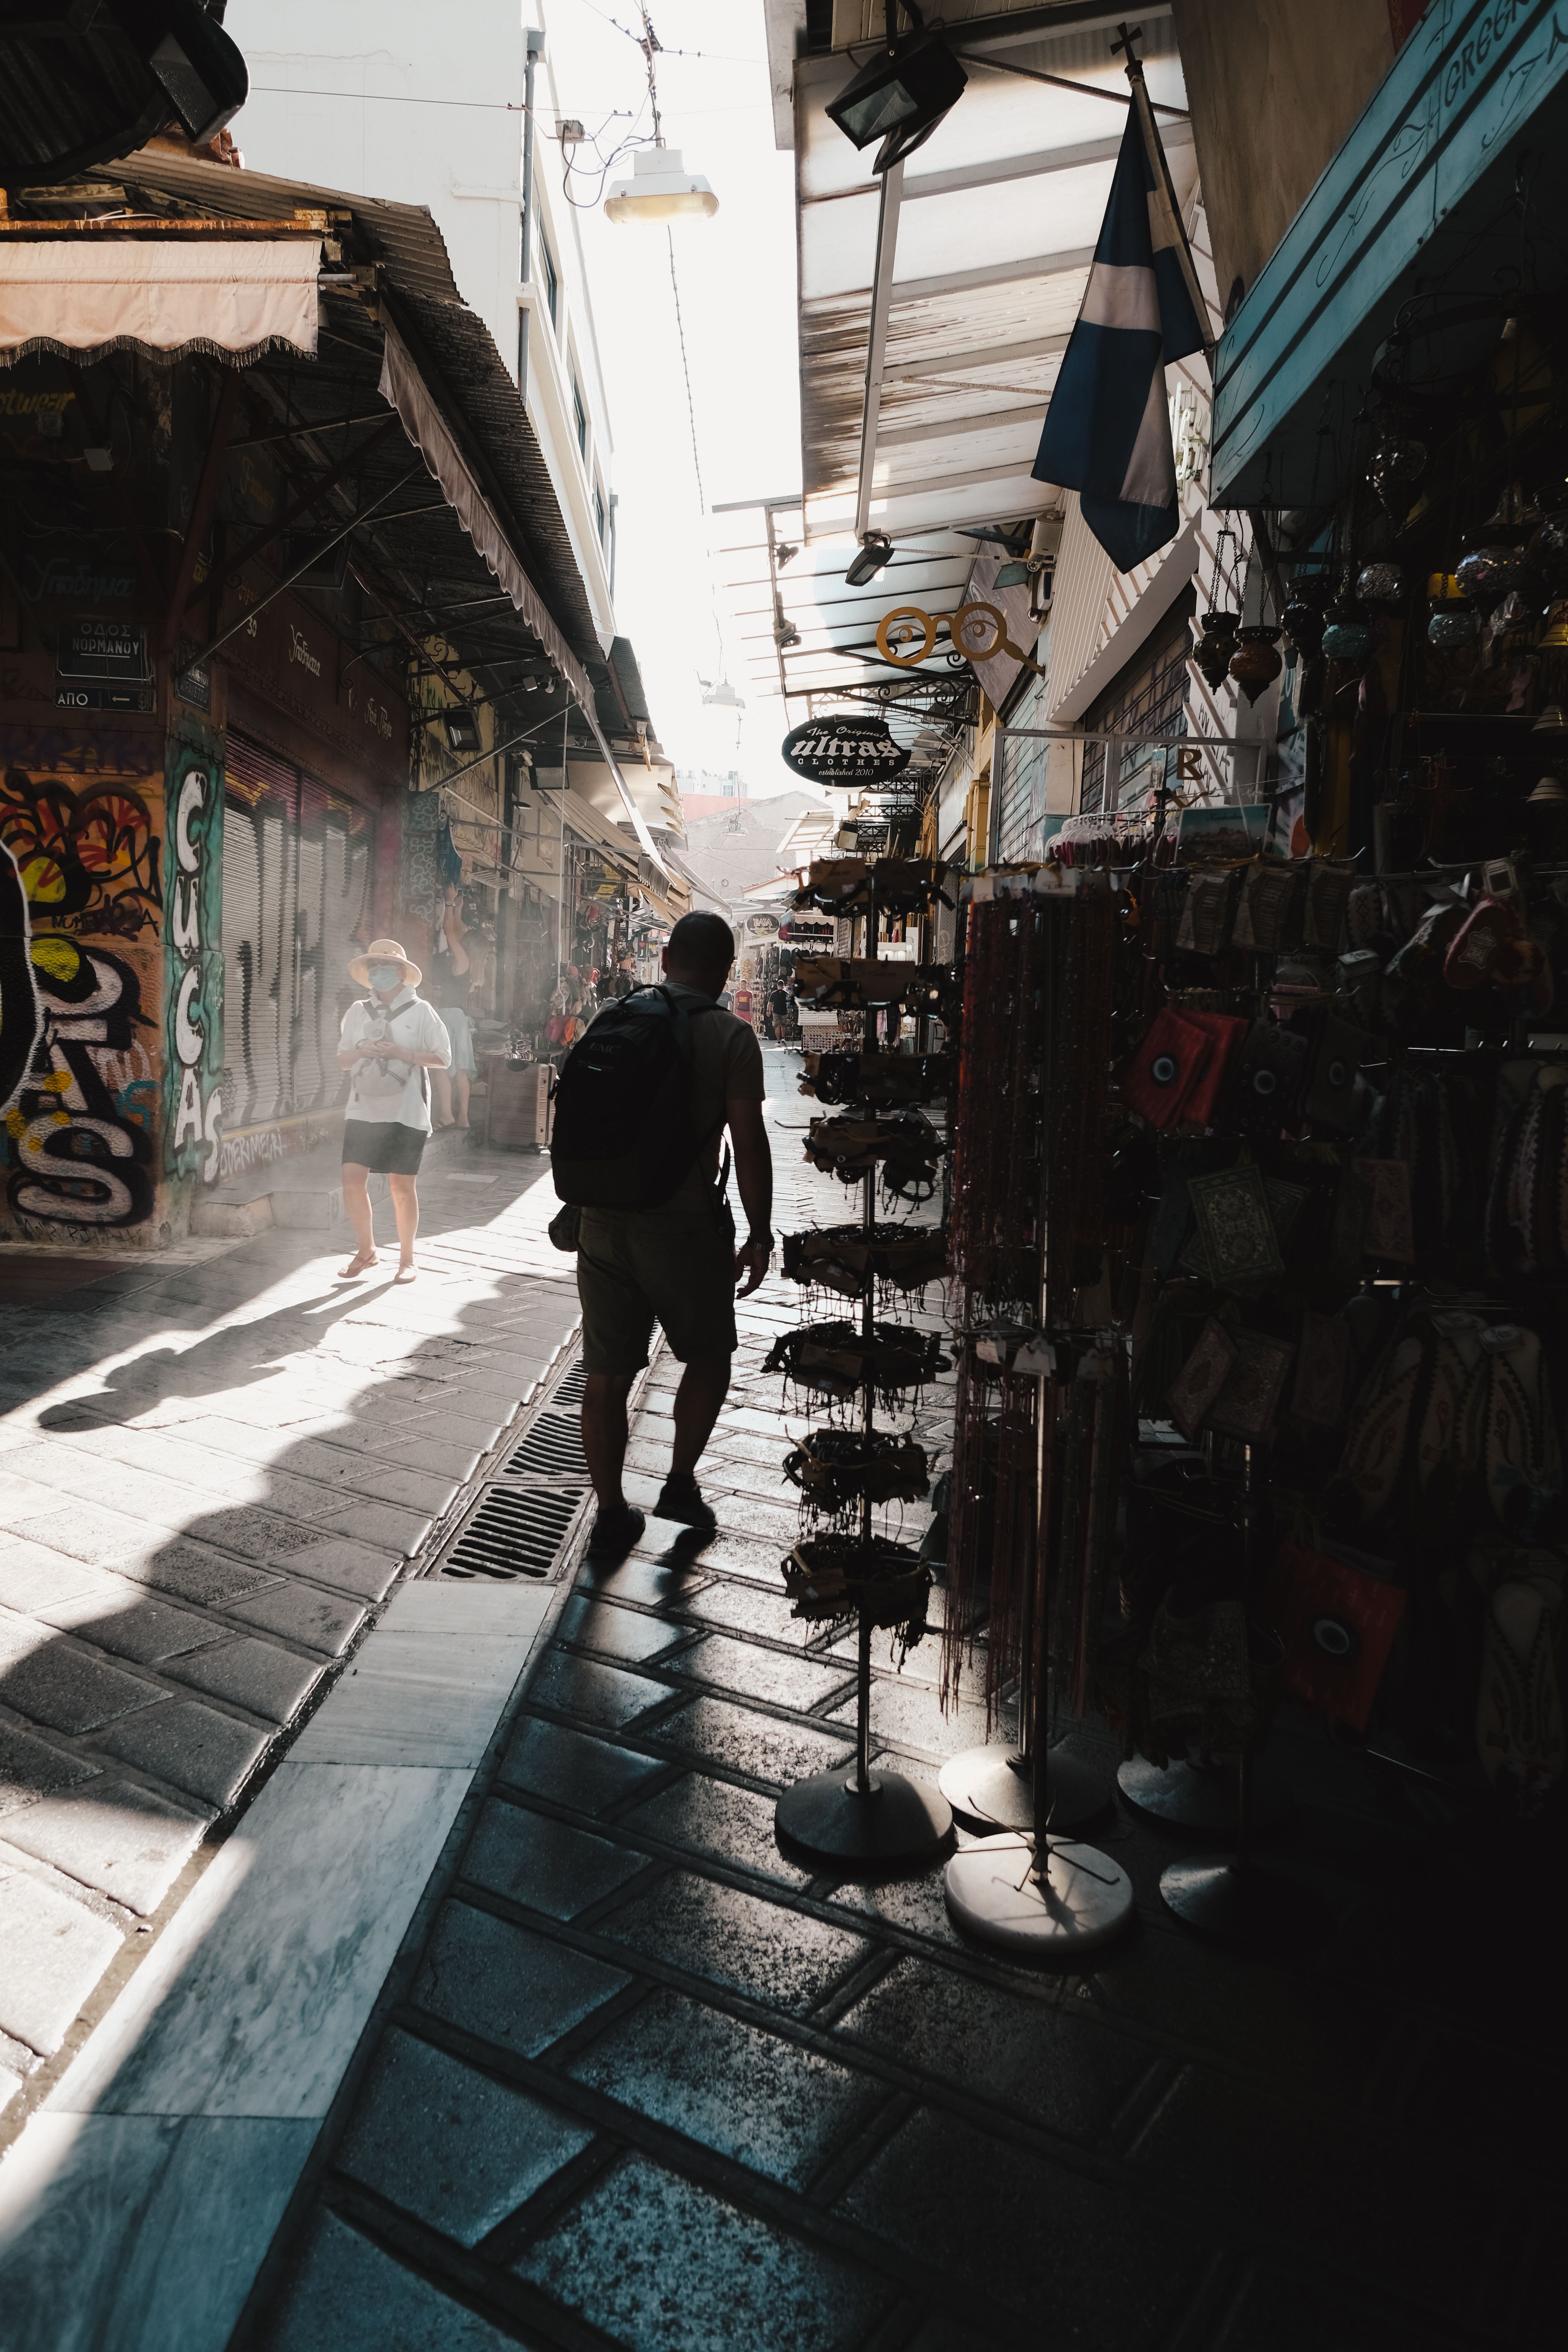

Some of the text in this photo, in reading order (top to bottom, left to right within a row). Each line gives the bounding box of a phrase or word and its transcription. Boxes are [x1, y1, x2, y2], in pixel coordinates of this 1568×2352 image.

[22, 554, 136, 604] Υποδημα
[81, 623, 131, 637] ΟΔΟΣ
[247, 617, 257, 637] 30
[72, 637, 139, 655] ΝΟΡΜΑΝΟΥ
[58, 692, 88, 706] ΑΠΟ
[807, 726, 886, 738] The Original
[790, 736, 902, 758] ultras
